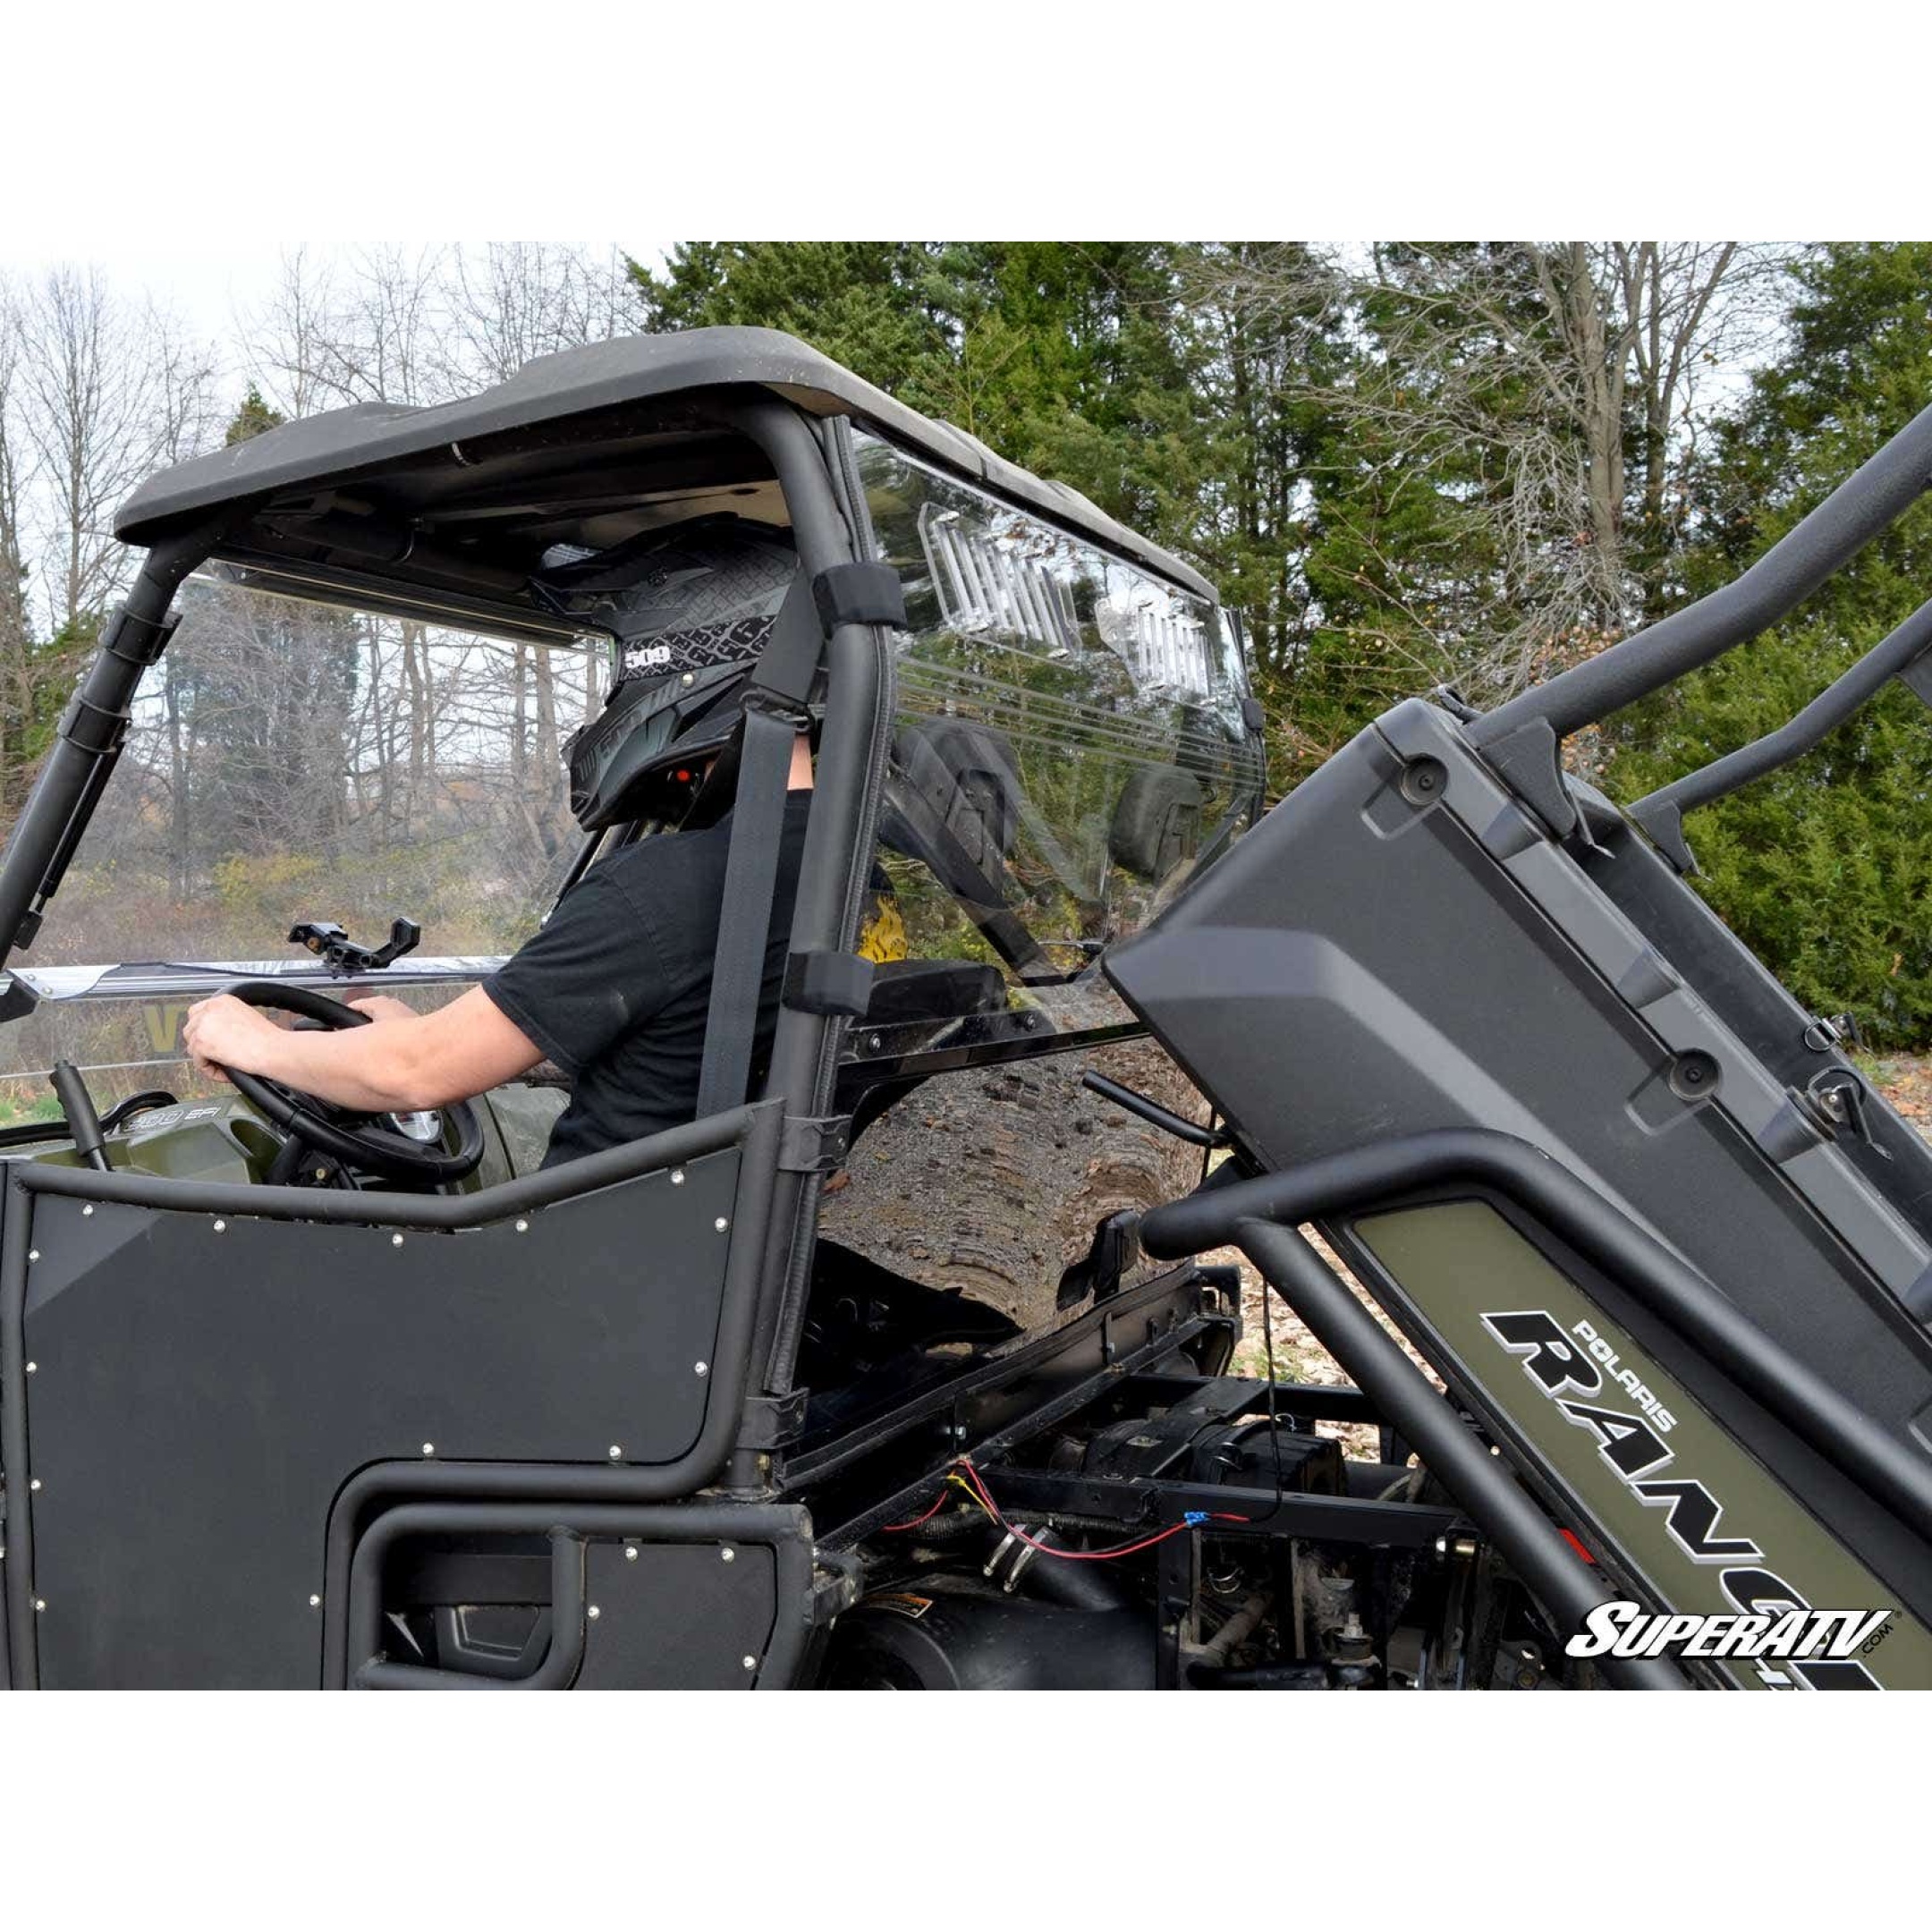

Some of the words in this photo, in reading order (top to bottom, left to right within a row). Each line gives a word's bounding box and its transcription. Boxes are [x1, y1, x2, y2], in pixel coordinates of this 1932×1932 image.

[625, 645, 670, 668] 509
[1572, 1319, 1680, 1433] POLARIS
[1479, 1310, 1885, 1690] RANG
